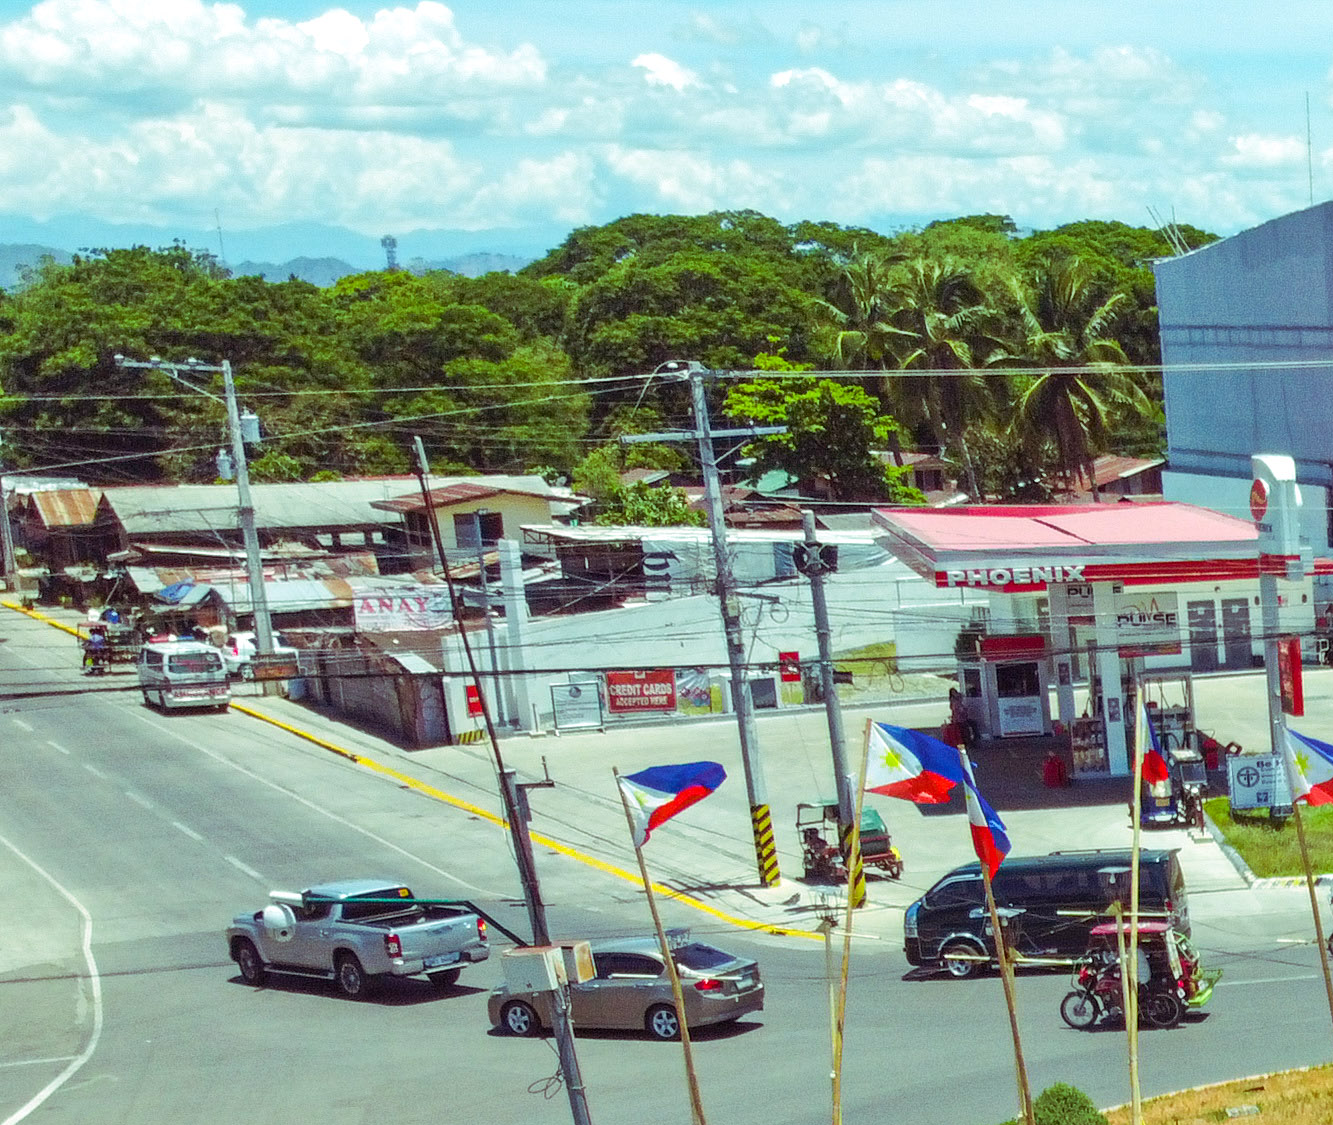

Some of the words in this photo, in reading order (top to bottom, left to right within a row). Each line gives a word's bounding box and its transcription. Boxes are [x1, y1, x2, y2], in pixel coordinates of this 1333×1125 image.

[946, 565, 1087, 587] PHOENIX
[609, 684, 642, 696] CREDIT
[643, 683, 673, 696] CARDS
[616, 696, 649, 706] ACCEPTED
